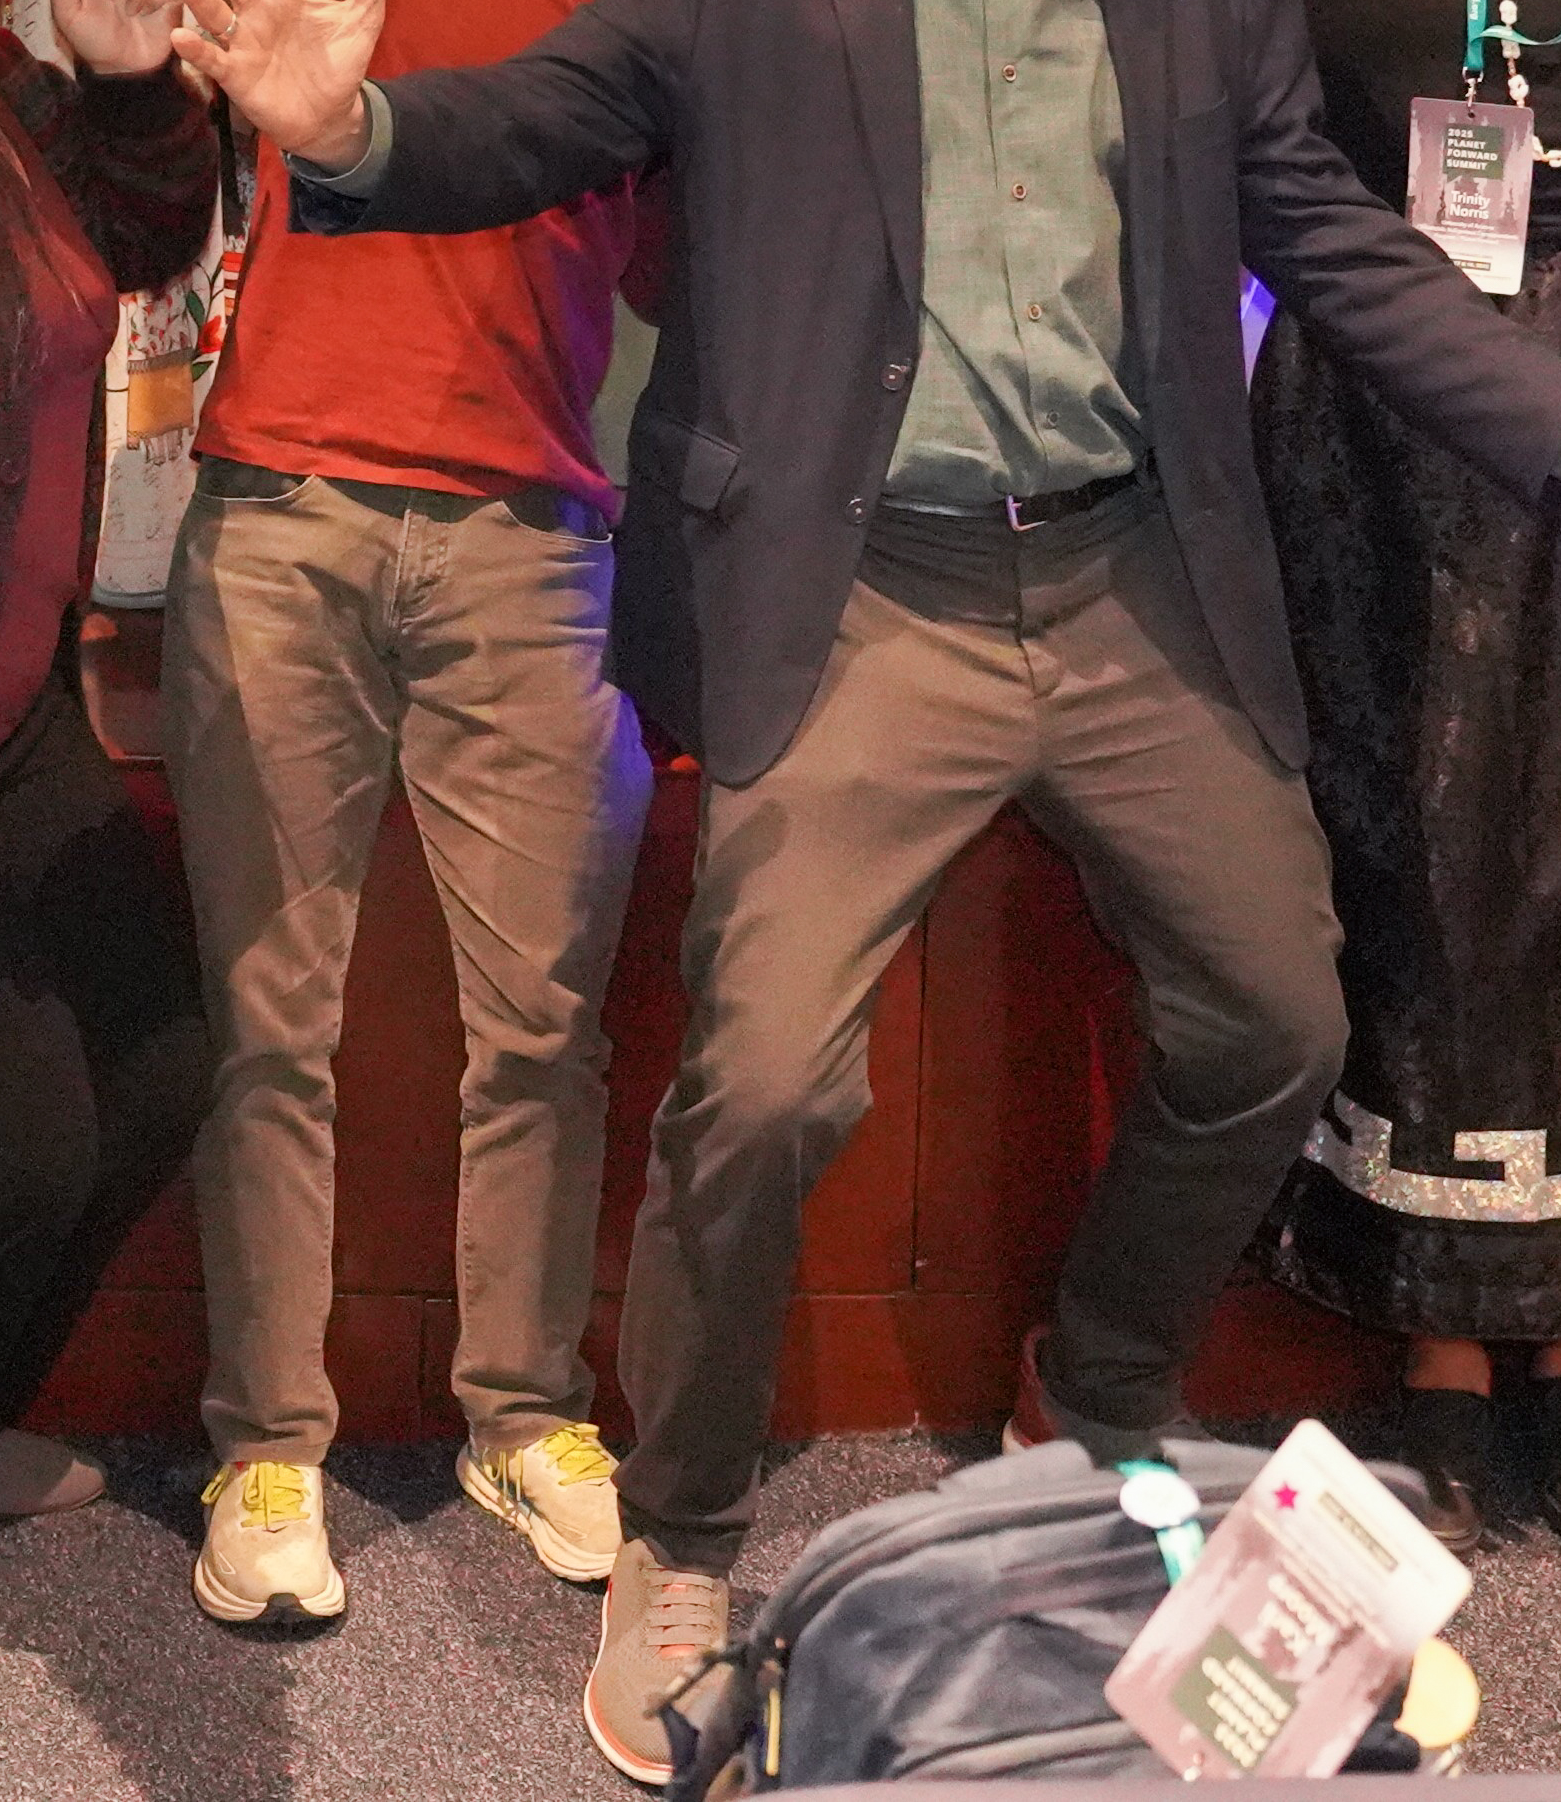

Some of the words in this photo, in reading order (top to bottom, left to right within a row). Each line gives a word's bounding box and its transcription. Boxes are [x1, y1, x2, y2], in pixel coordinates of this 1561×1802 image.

[1447, 138, 1487, 149] PLANET
[1446, 148, 1498, 161] FORWARD
[1446, 158, 1488, 170] SUMMIT
[1451, 190, 1491, 210] Trinity
